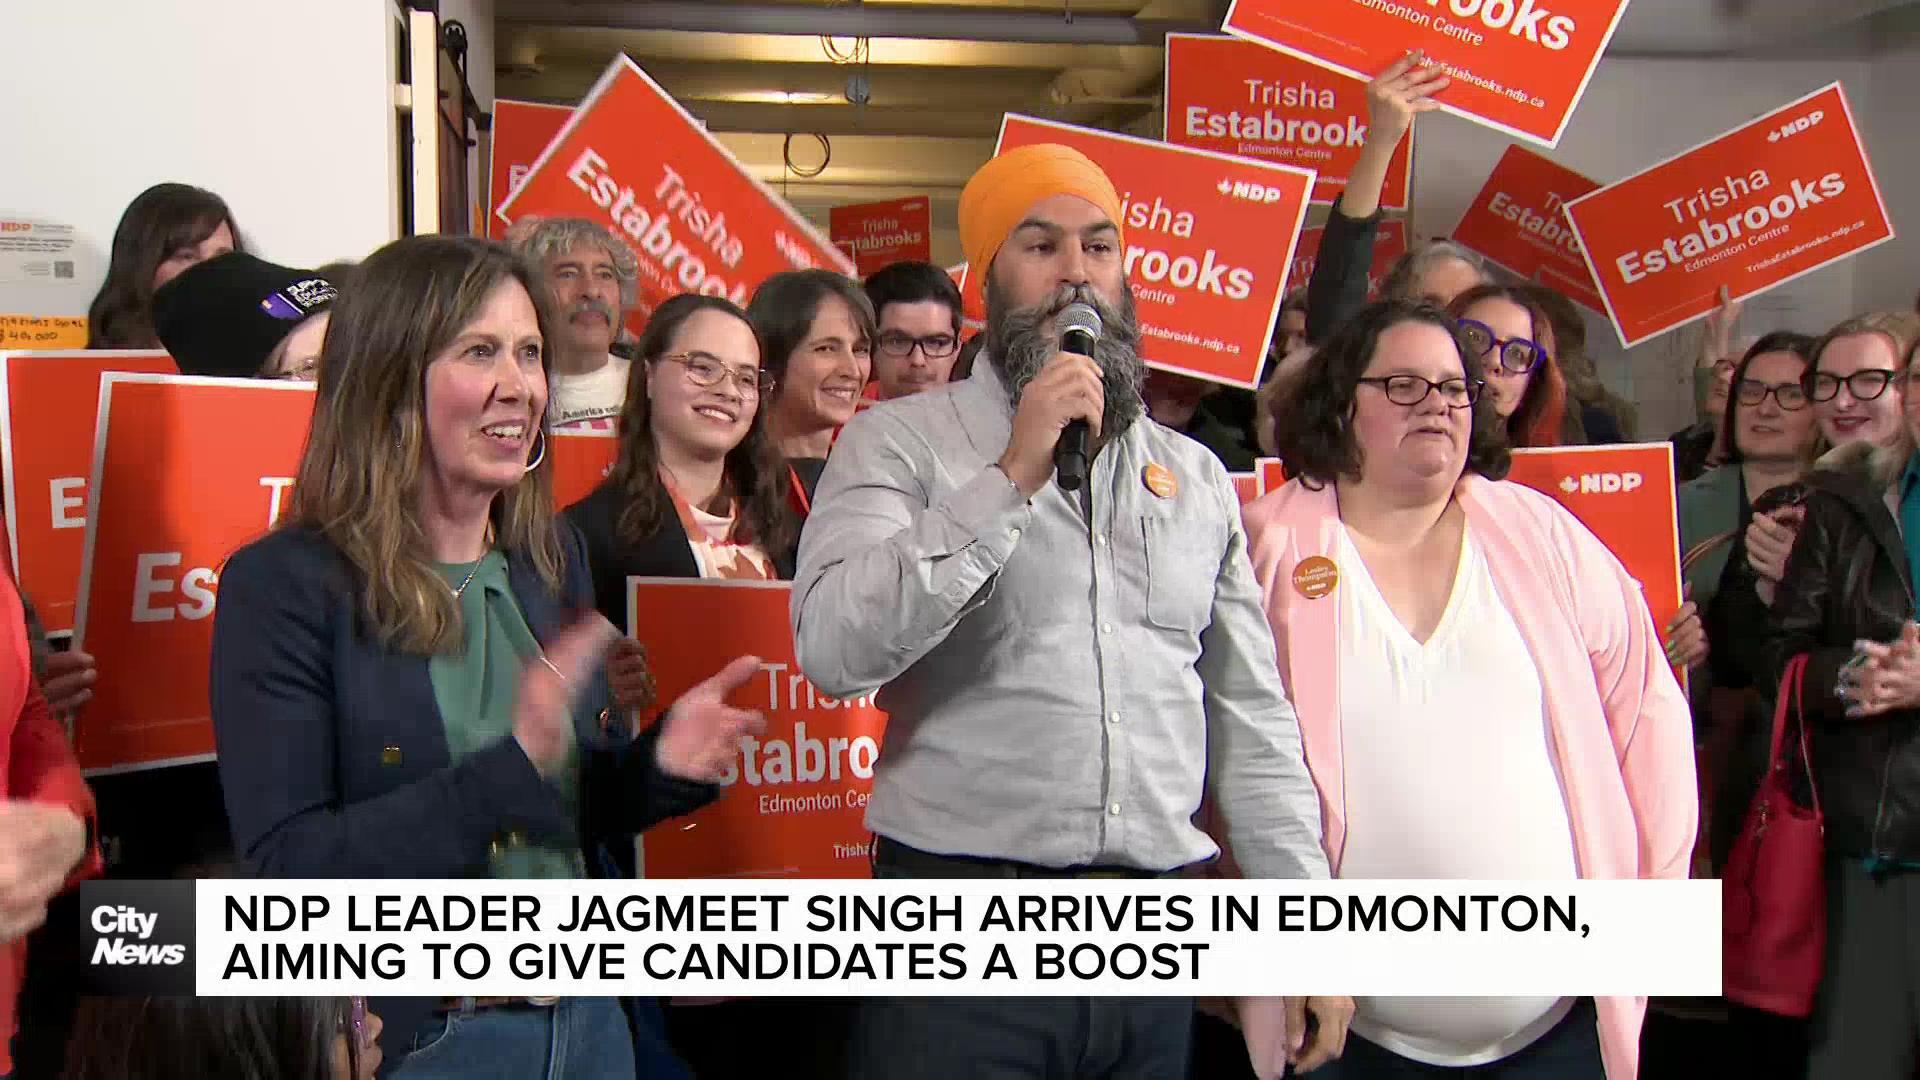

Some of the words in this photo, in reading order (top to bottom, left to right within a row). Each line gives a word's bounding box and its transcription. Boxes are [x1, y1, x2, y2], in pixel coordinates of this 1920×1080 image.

[1433, 17, 1484, 46] Centre
[1244, 80, 1335, 109] Trisha
[1186, 106, 1367, 147] Estabrook
[1780, 110, 1824, 139] NDP
[1233, 182, 1280, 204] NDP
[1663, 168, 1770, 223] Trisha
[655, 162, 743, 270] Trisha
[1121, 192, 1194, 238] isha
[1616, 171, 1845, 284] Estabrooks
[1685, 241, 1747, 272] Edmonton
[1748, 224, 1790, 247] Centre
[1124, 244, 1254, 300] rooks
[1140, 322, 1241, 355] Estabrooks.ndp.ca
[1580, 472, 1642, 494] NDP
[760, 792, 841, 814] Edmonton
